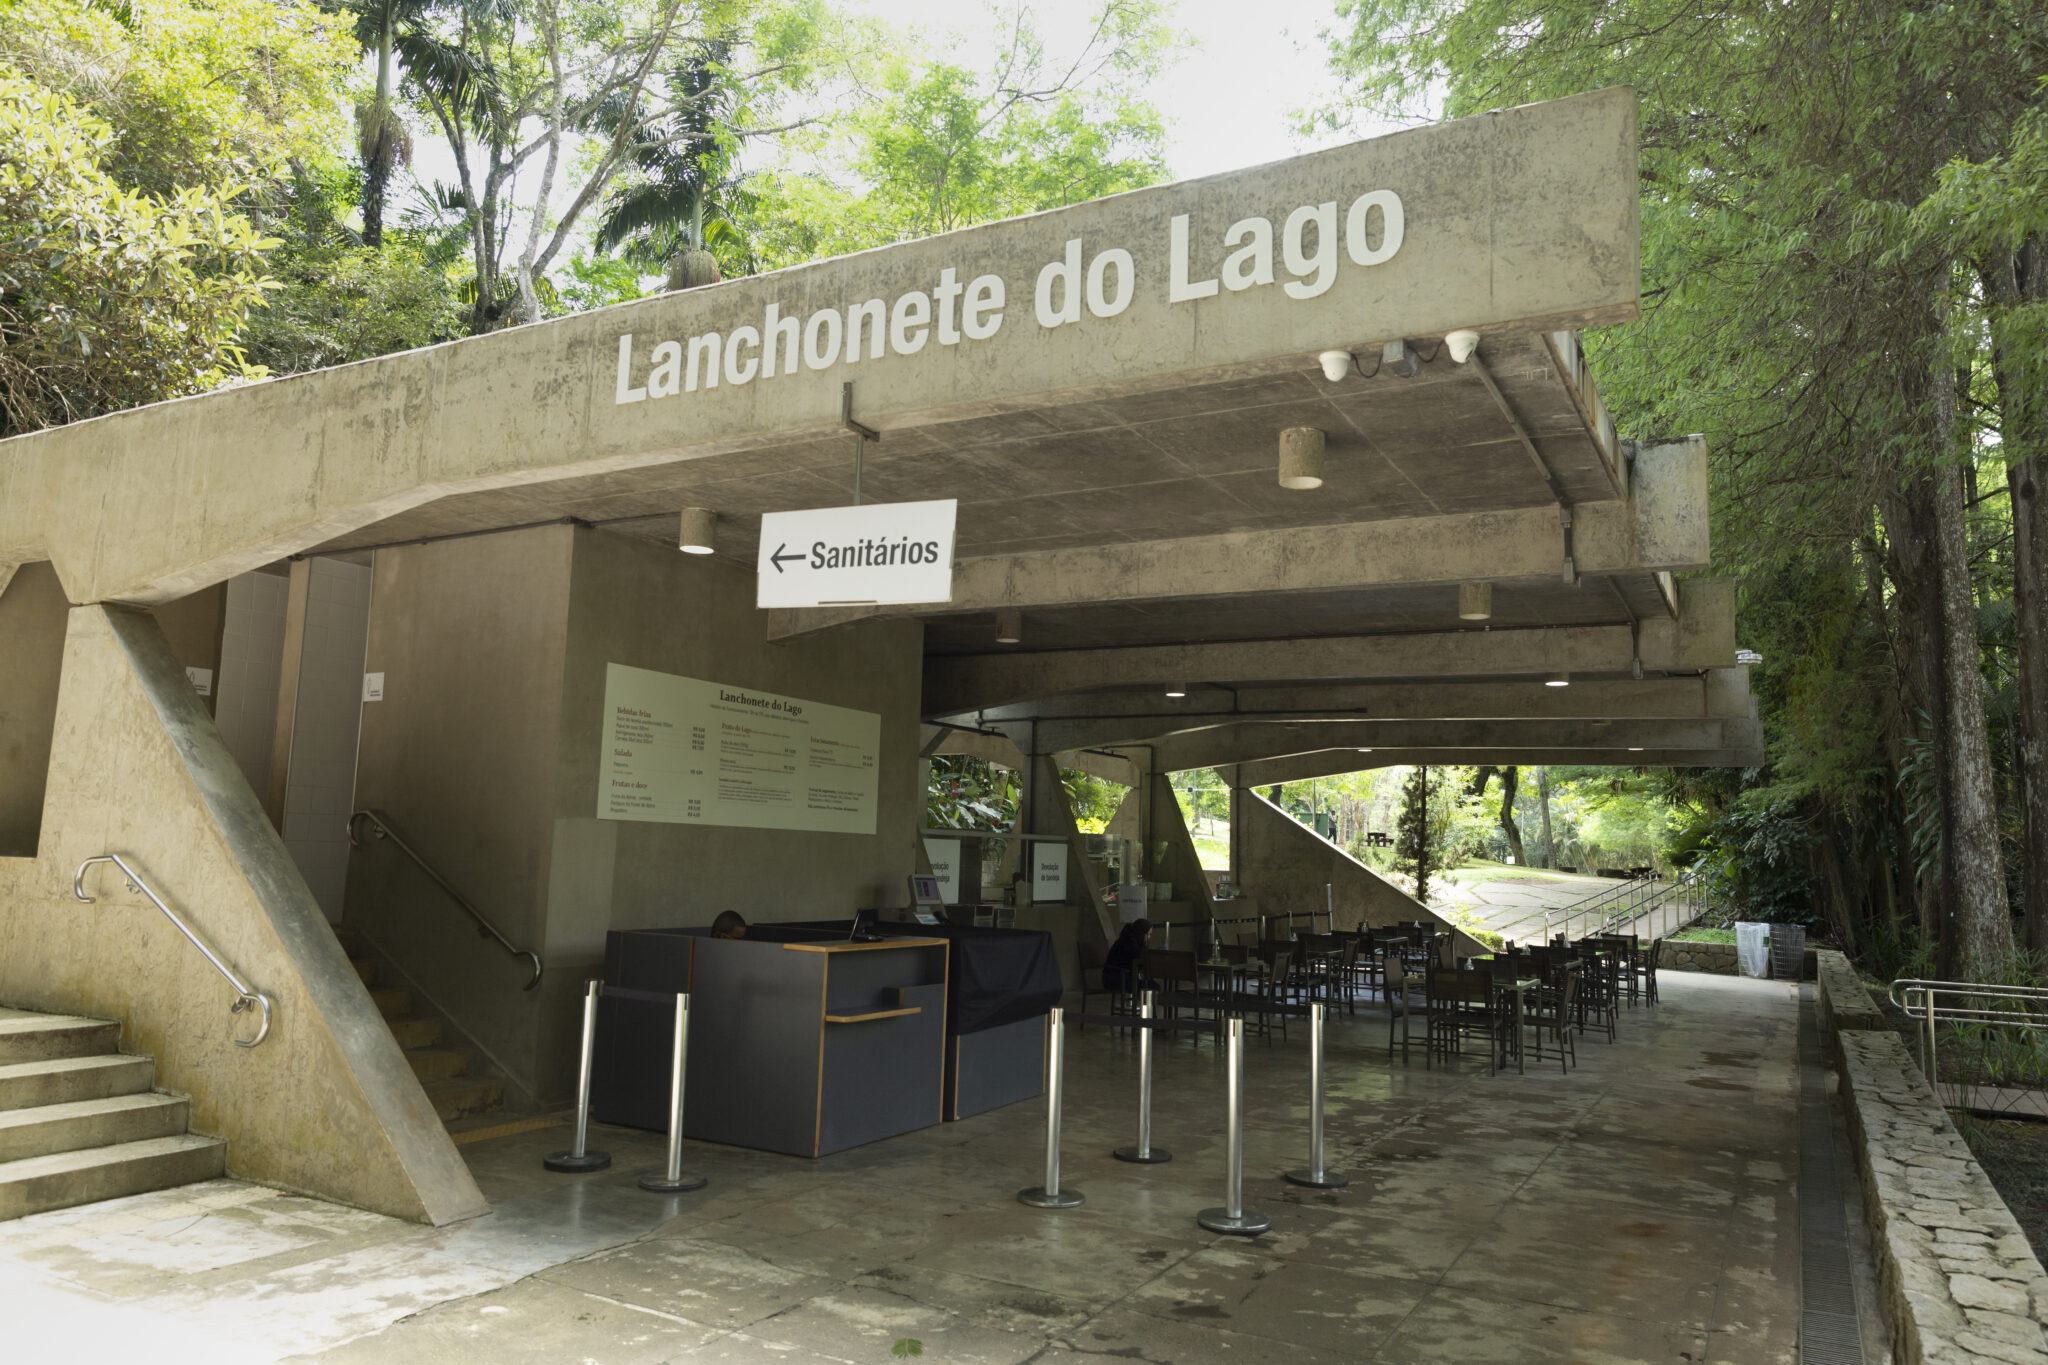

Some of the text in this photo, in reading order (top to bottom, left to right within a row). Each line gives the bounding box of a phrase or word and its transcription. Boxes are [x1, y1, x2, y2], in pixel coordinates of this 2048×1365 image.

[614, 188, 1405, 406] Lanchonete do Lago
[811, 536, 939, 570] Sanitários
[719, 689, 770, 709] Lanchonete
[771, 699, 783, 711] do
[783, 701, 803, 716] Lago
[617, 706, 638, 717] Bebidas
[614, 748, 633, 757] Salada
[611, 779, 631, 788] Frutas
[930, 861, 949, 872] volução
[1041, 862, 1059, 872] Devolução
[935, 874, 951, 884] andeja
[1041, 874, 1060, 883] de bandeja
